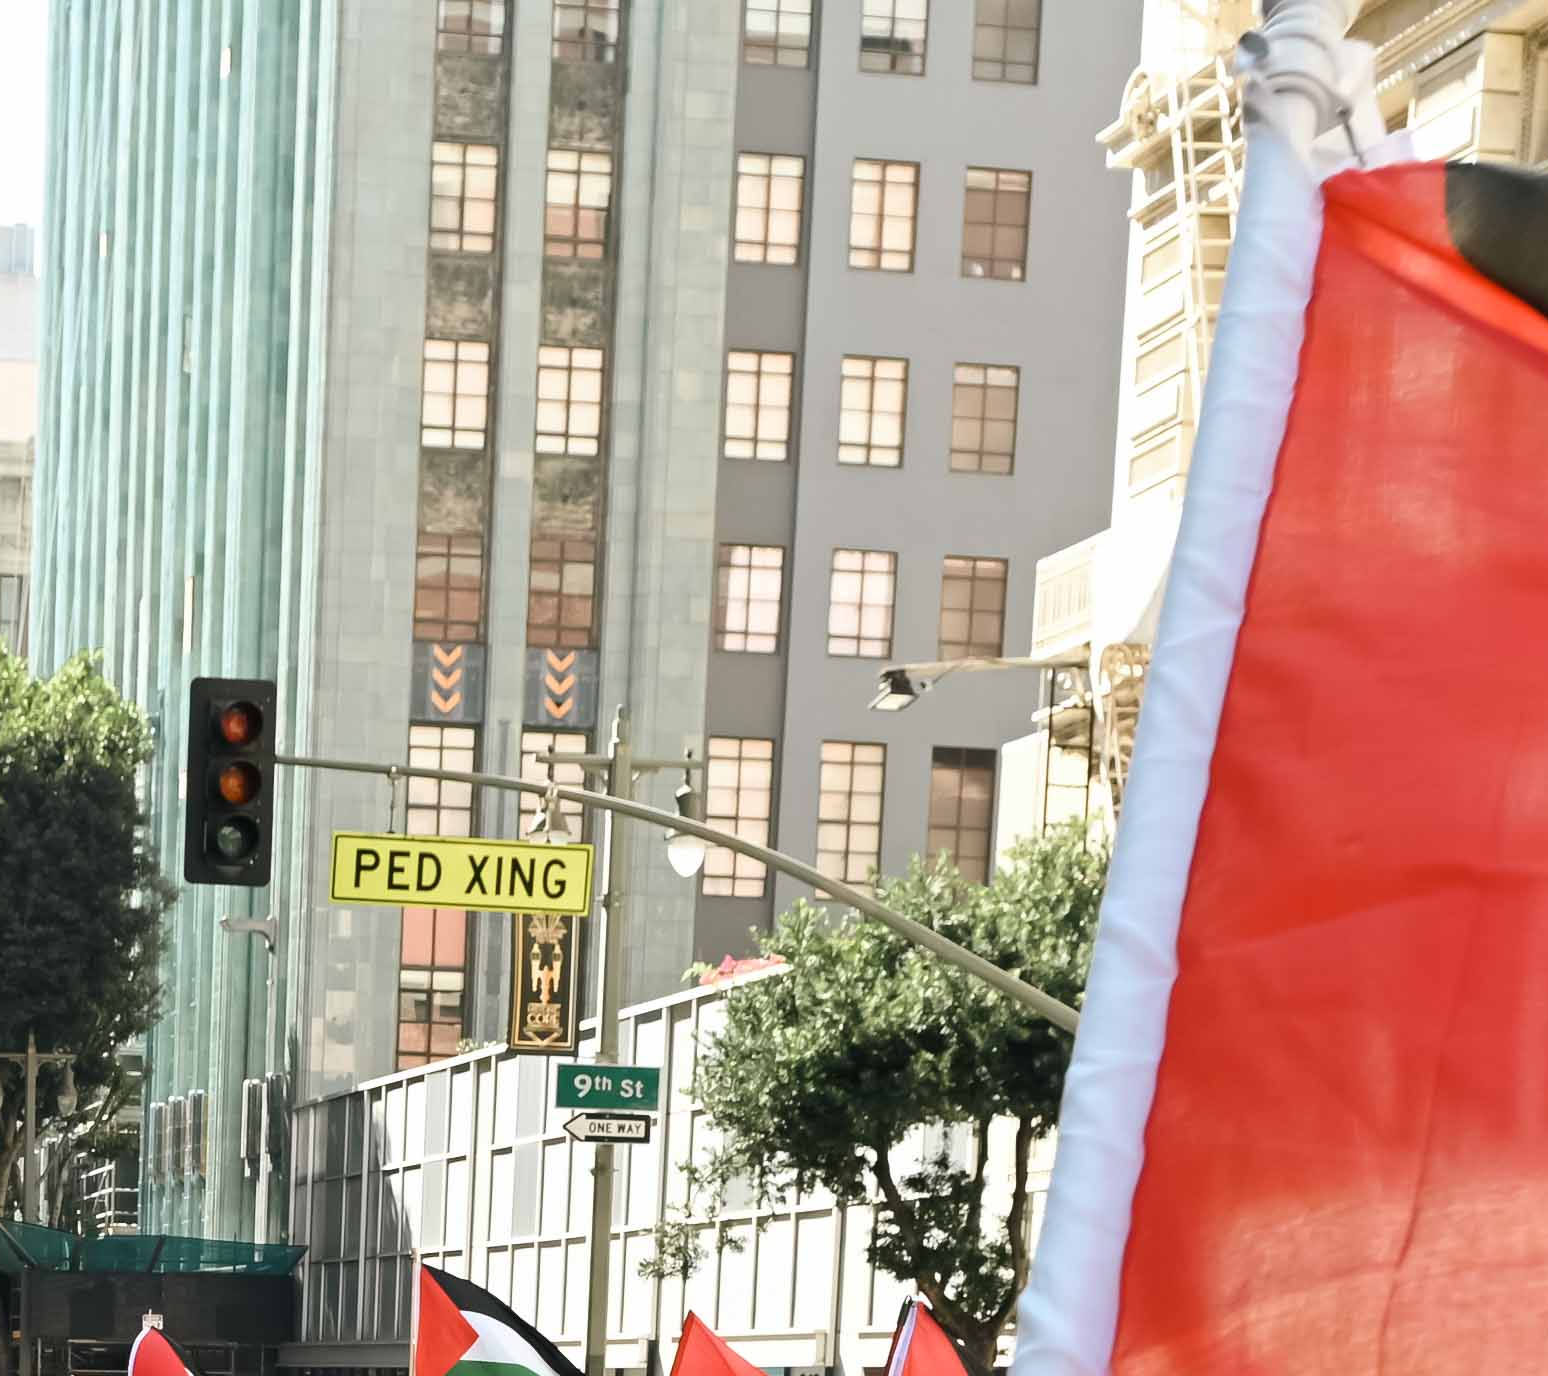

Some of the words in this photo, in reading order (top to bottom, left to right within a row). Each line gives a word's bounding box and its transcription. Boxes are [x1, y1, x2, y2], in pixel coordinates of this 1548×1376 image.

[353, 848, 443, 892] PED
[465, 854, 567, 899] XING
[573, 1073, 612, 1098] 9th
[620, 1079, 644, 1099] St
[588, 1121, 613, 1134] ONE
[617, 1122, 642, 1135] WAY
